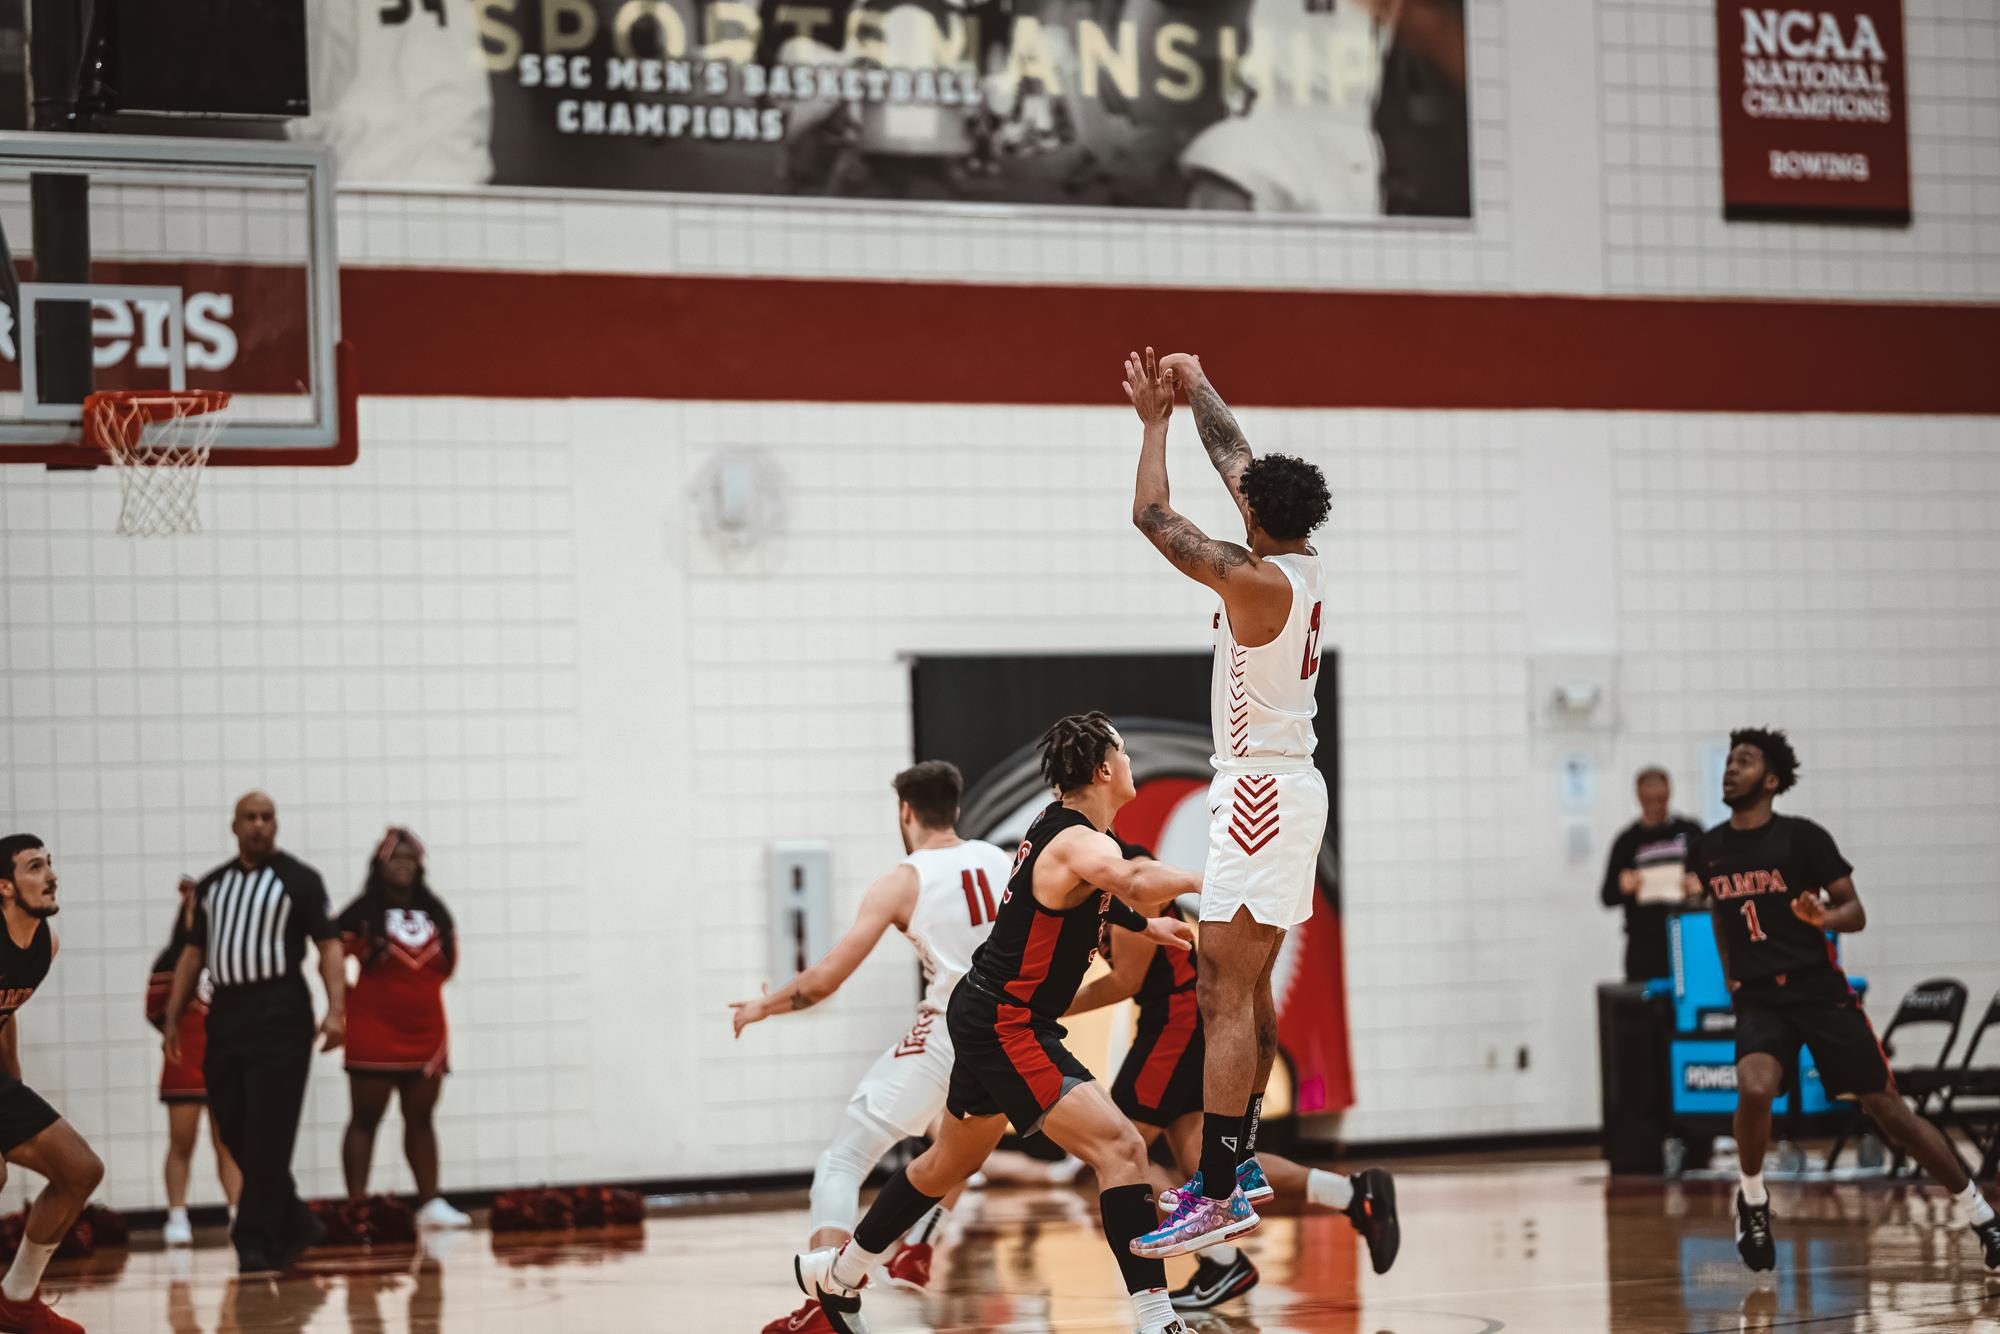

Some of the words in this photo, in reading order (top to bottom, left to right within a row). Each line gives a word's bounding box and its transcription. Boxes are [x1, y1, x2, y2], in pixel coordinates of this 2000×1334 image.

[1741, 9, 1886, 61] NCAA
[519, 54, 592, 89] SSC
[606, 59, 729, 95] MEN'S
[743, 62, 982, 106] BASKETBALL
[1743, 59, 1888, 93] NATIONAL
[557, 101, 785, 142] CHAMPIONS
[1742, 89, 1891, 123] CHAMPIONS
[960, 867, 998, 927] 11
[1710, 868, 1788, 899] TAMPA
[1740, 899, 1768, 942] 1
[1685, 1064, 1738, 1090] POWE
